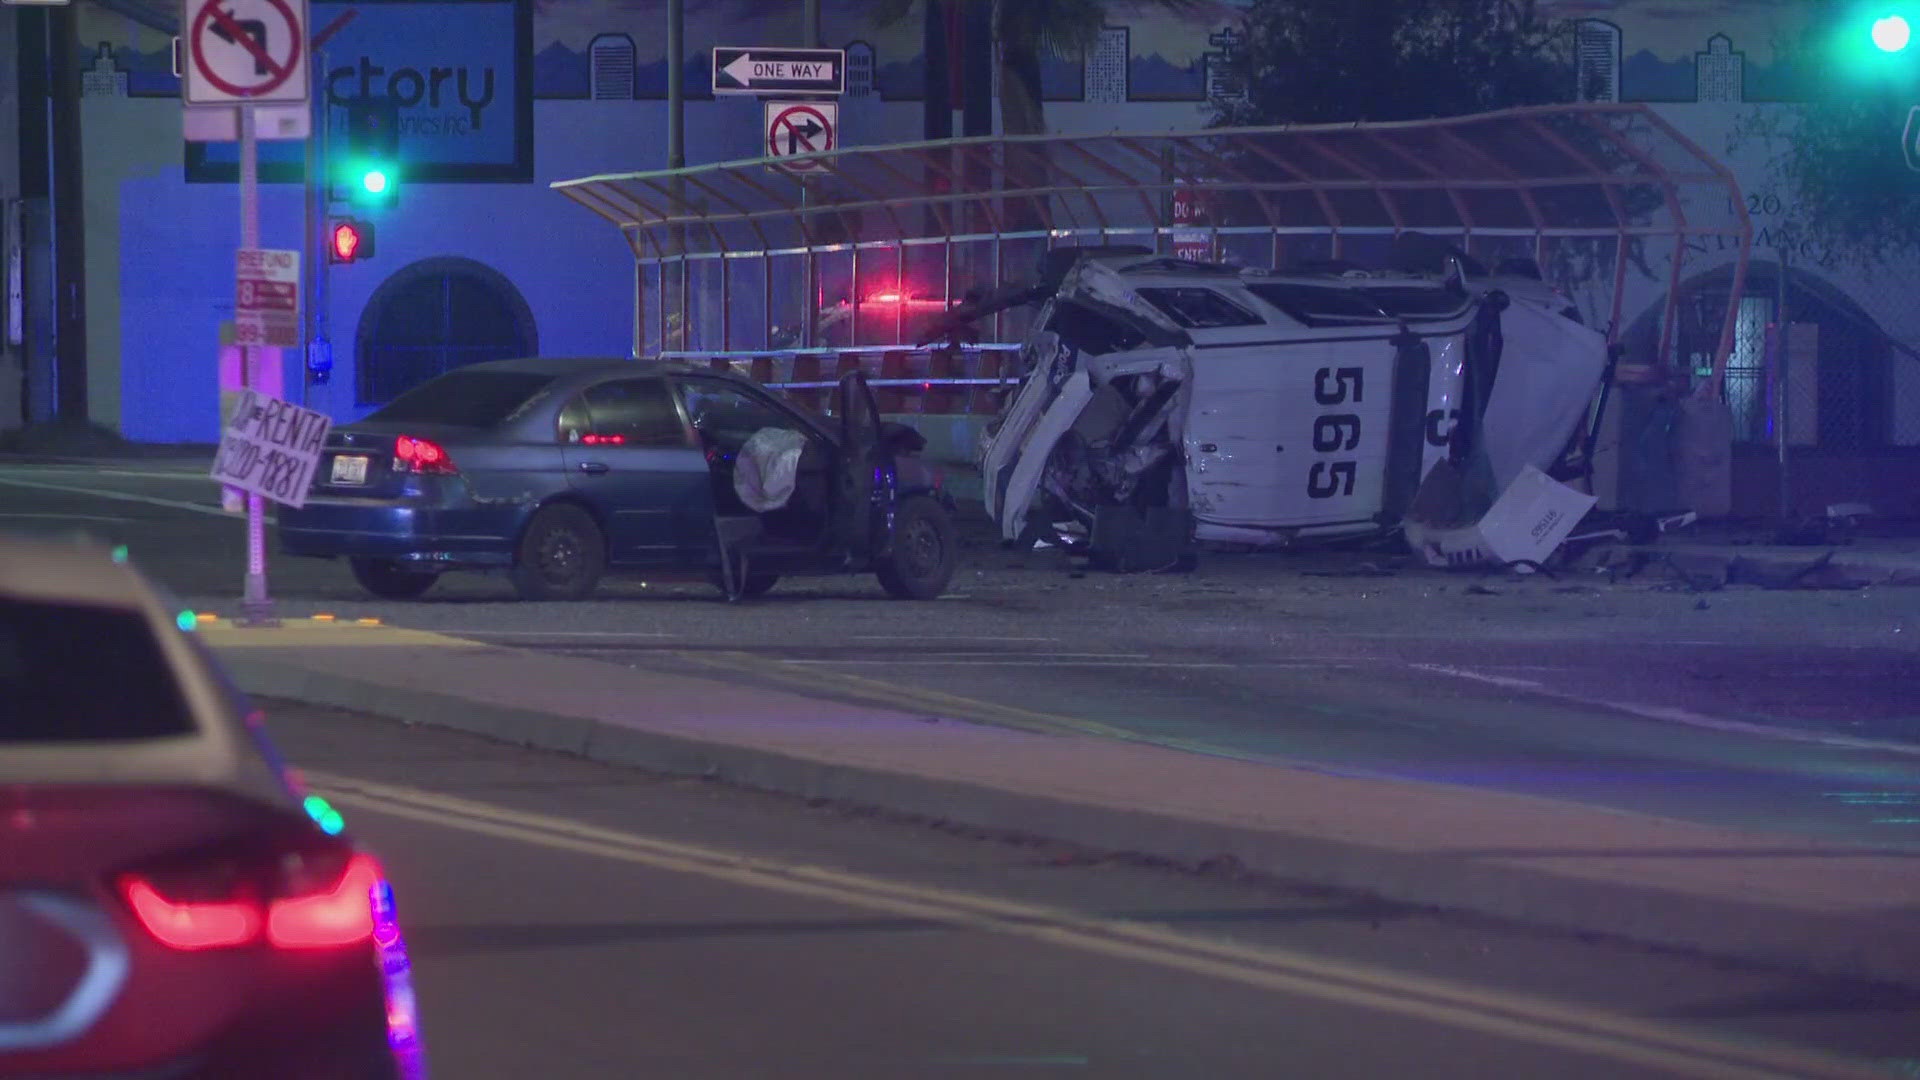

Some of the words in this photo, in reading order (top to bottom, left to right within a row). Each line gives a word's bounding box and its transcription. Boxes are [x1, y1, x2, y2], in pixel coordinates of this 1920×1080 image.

[753, 63, 785, 77] ONE
[791, 63, 822, 78] WAY
[1178, 248, 1211, 263] ENTE
[256, 397, 330, 456] RENTA
[1307, 366, 1364, 499] 565
